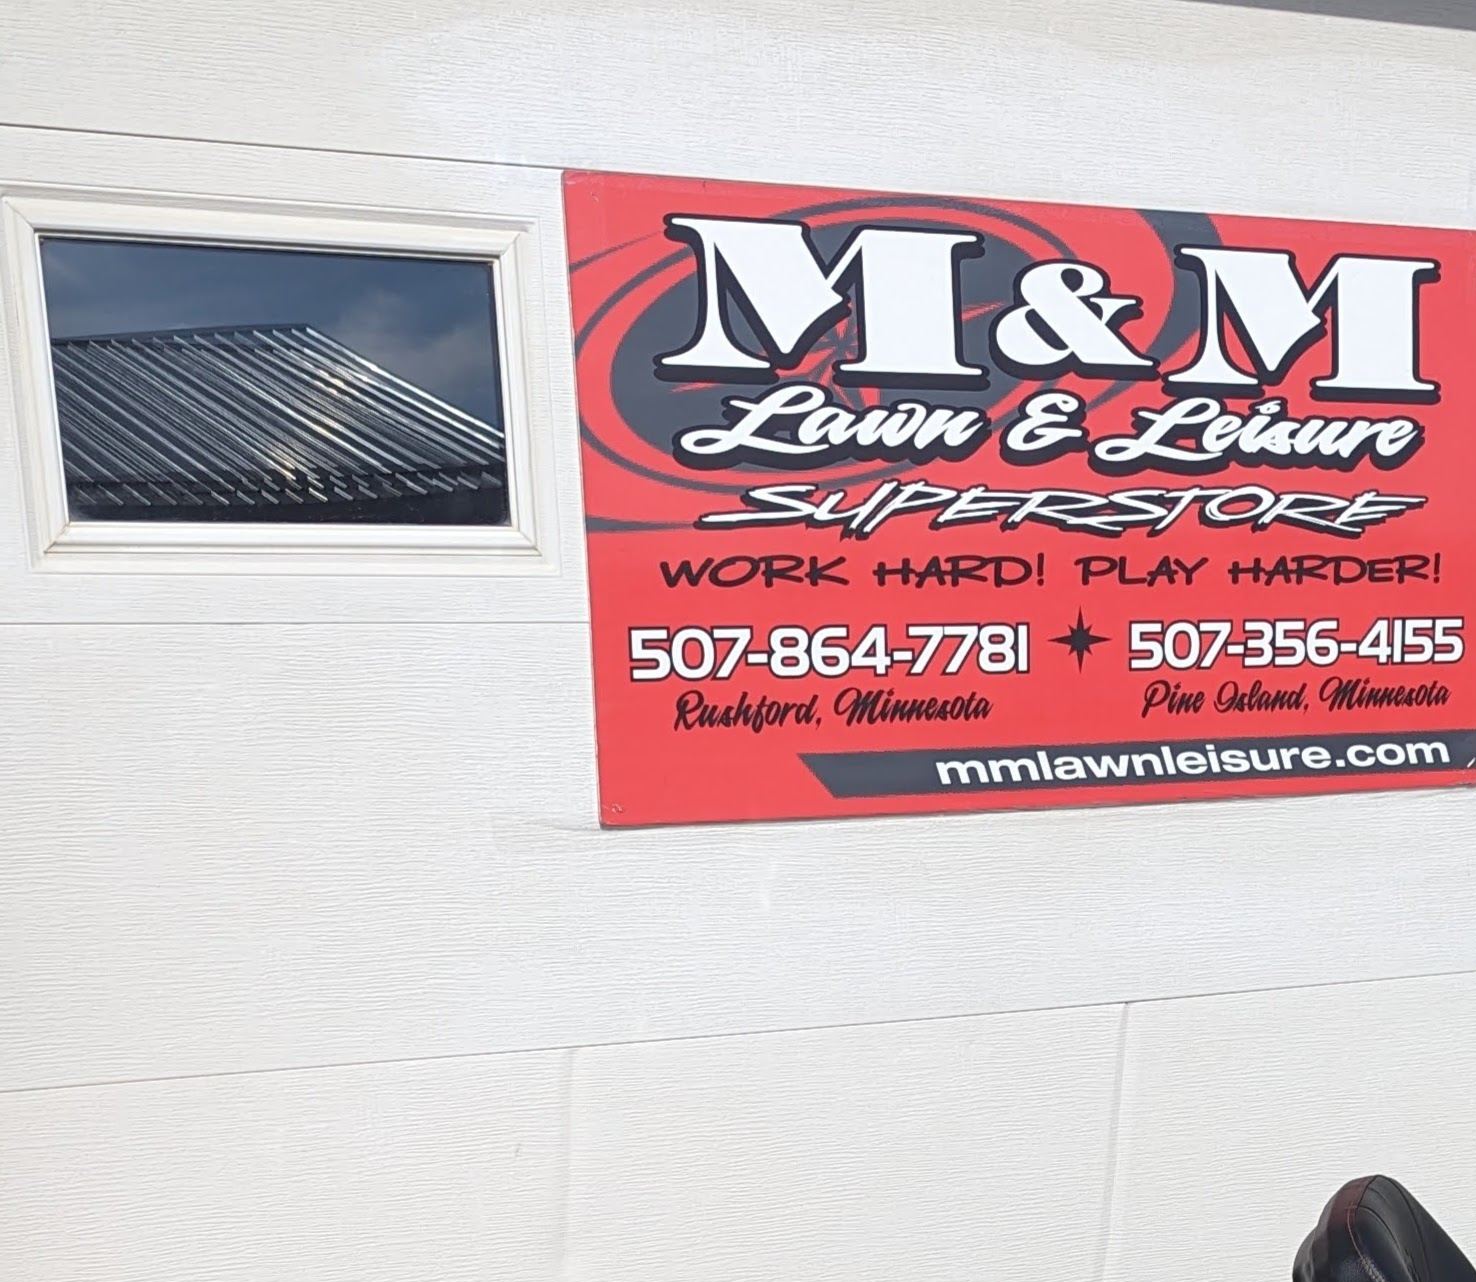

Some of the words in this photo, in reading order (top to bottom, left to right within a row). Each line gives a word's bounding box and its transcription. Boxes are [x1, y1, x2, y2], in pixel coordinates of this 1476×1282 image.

[682, 380, 986, 462] Lawn
[1009, 391, 1086, 456] &
[1092, 396, 1420, 464] Leisure
[696, 482, 1426, 535] SUPERSTORE
[660, 554, 849, 588] WORK
[872, 552, 1046, 588] HARD!
[1075, 556, 1206, 587] PLAY
[1228, 552, 1442, 585] HARDER!
[628, 622, 1030, 681] 507-864-7781
[1128, 616, 1465, 672] 507-356-4155
[673, 690, 822, 732] Rushford,
[833, 687, 994, 728] Minnesota
[1141, 680, 1206, 719] Pine
[1211, 680, 1309, 715] Island,
[1318, 678, 1452, 712] Minnesota
[935, 736, 1451, 787] mmlawnleisure.com
